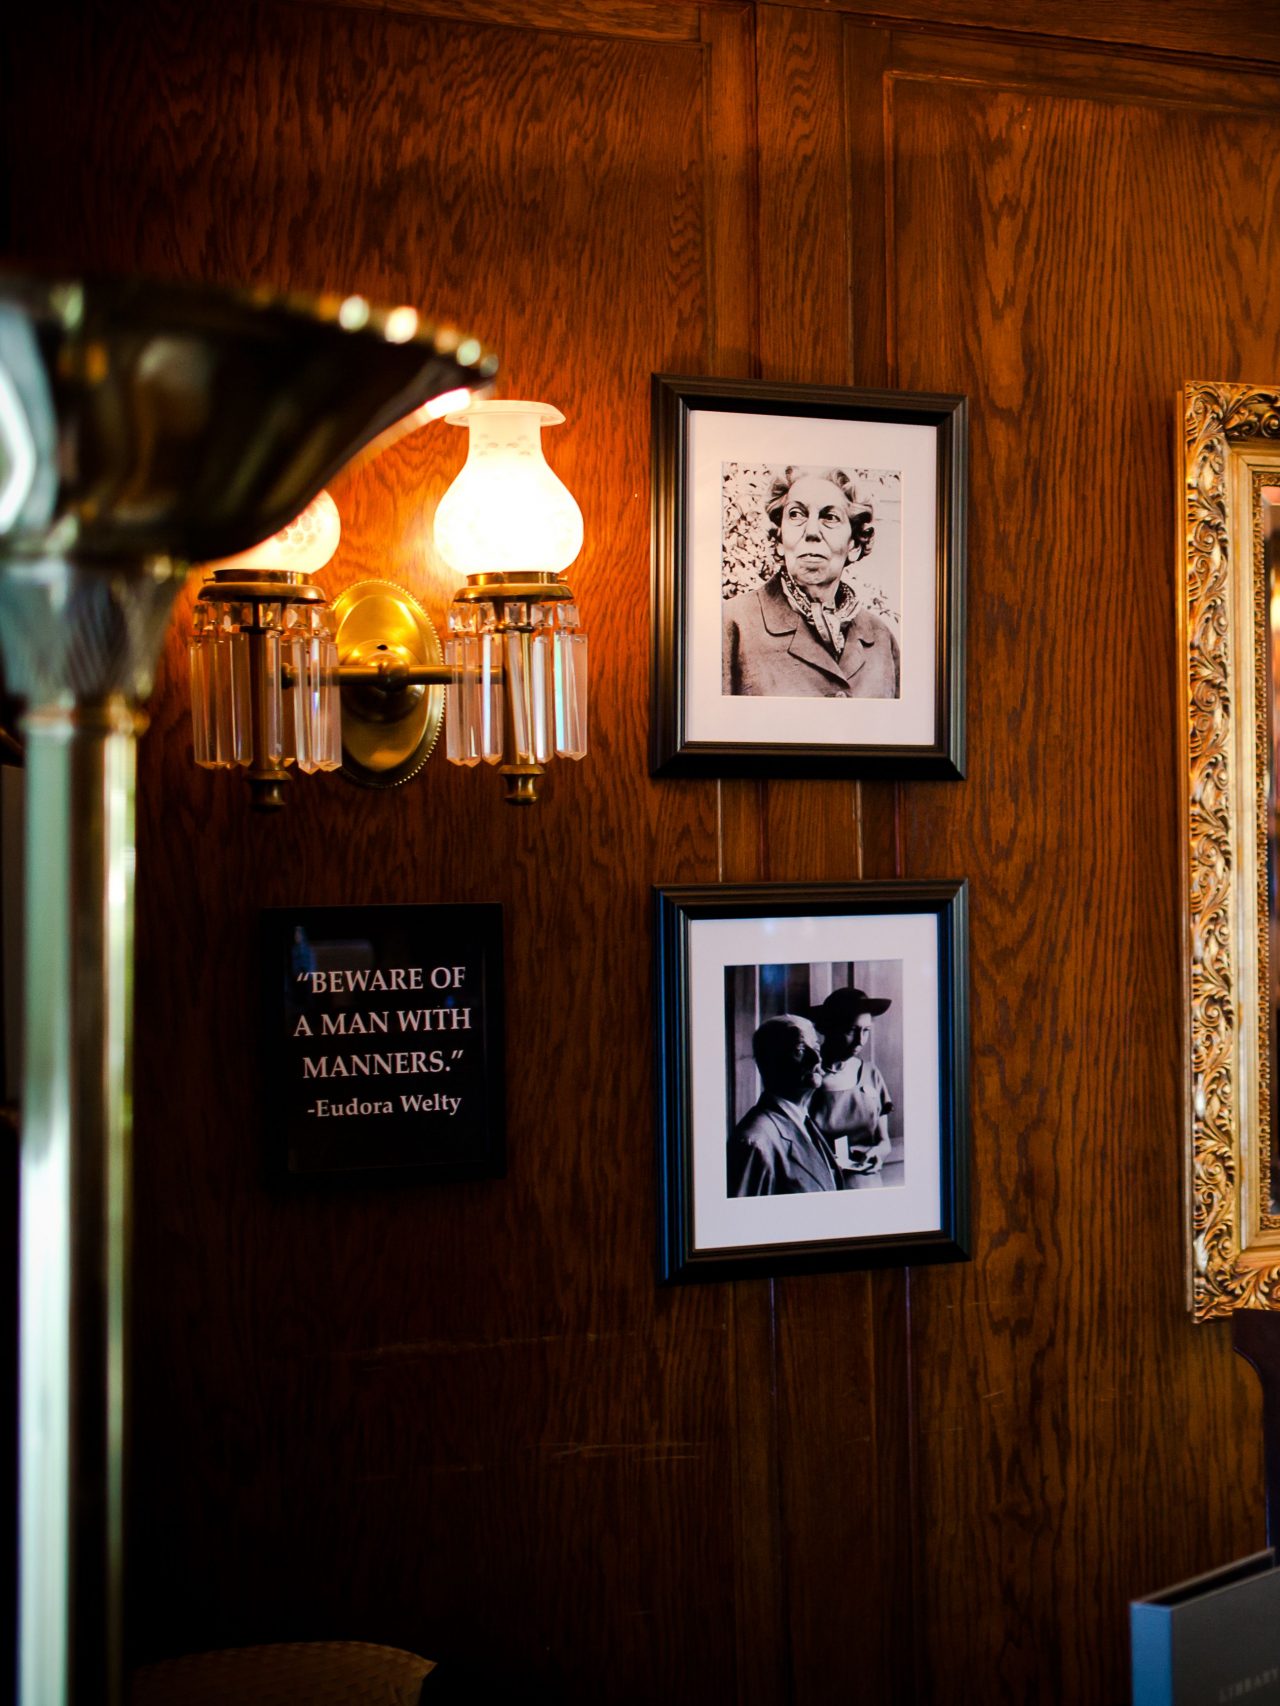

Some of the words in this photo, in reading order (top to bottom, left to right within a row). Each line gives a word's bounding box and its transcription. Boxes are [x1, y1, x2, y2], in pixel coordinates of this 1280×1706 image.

[297, 968, 424, 994] “BEWARE
[430, 966, 466, 989] OF
[293, 1014, 314, 1037] A
[320, 1011, 390, 1036] MAN
[396, 1007, 472, 1032] WITH
[302, 1049, 464, 1079] MANNERS.”
[307, 1097, 394, 1117] -Eudora
[399, 1093, 462, 1116] Welty
